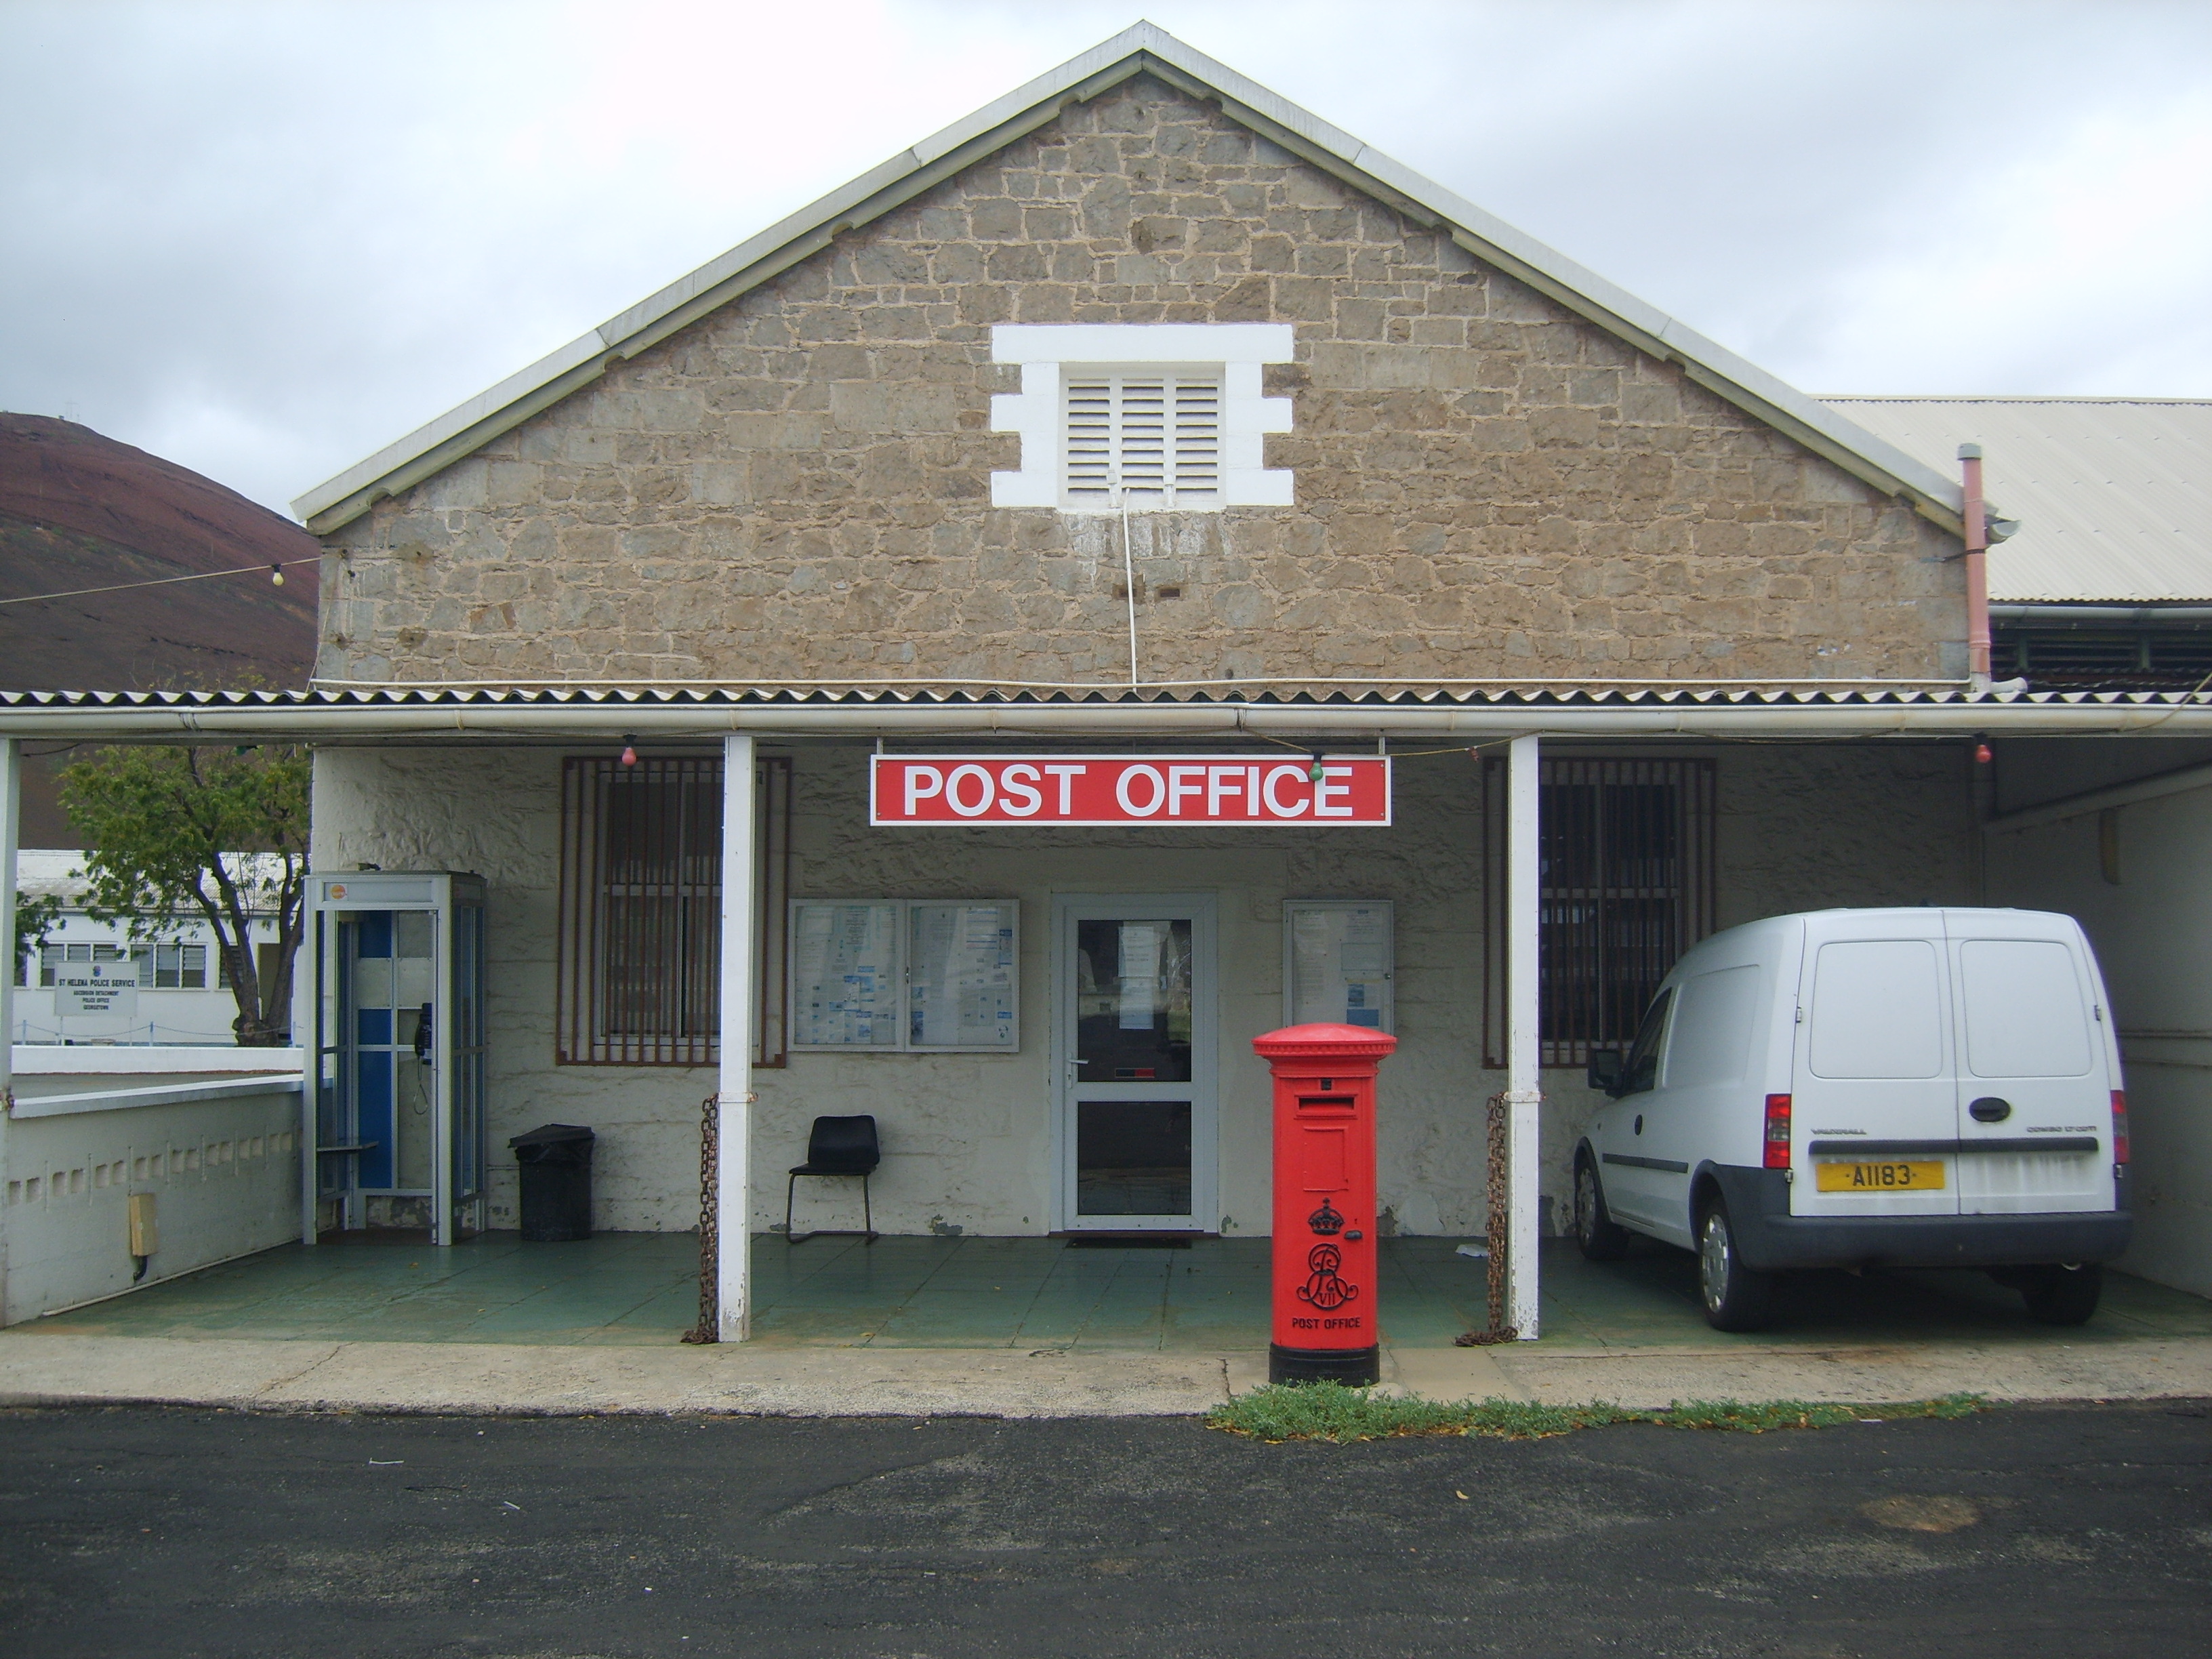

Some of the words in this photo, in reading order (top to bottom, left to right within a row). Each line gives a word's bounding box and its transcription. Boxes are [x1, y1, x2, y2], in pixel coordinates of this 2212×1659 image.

[905, 764, 1086, 817] POST
[1115, 764, 1353, 817] OFFICE
[67, 979, 88, 987] HELENA
[111, 979, 136, 987] SERVICE
[1852, 1164, 1911, 1187] A1183
[1292, 1317, 1320, 1329] POST
[1324, 1317, 1361, 1329] OFFICE
